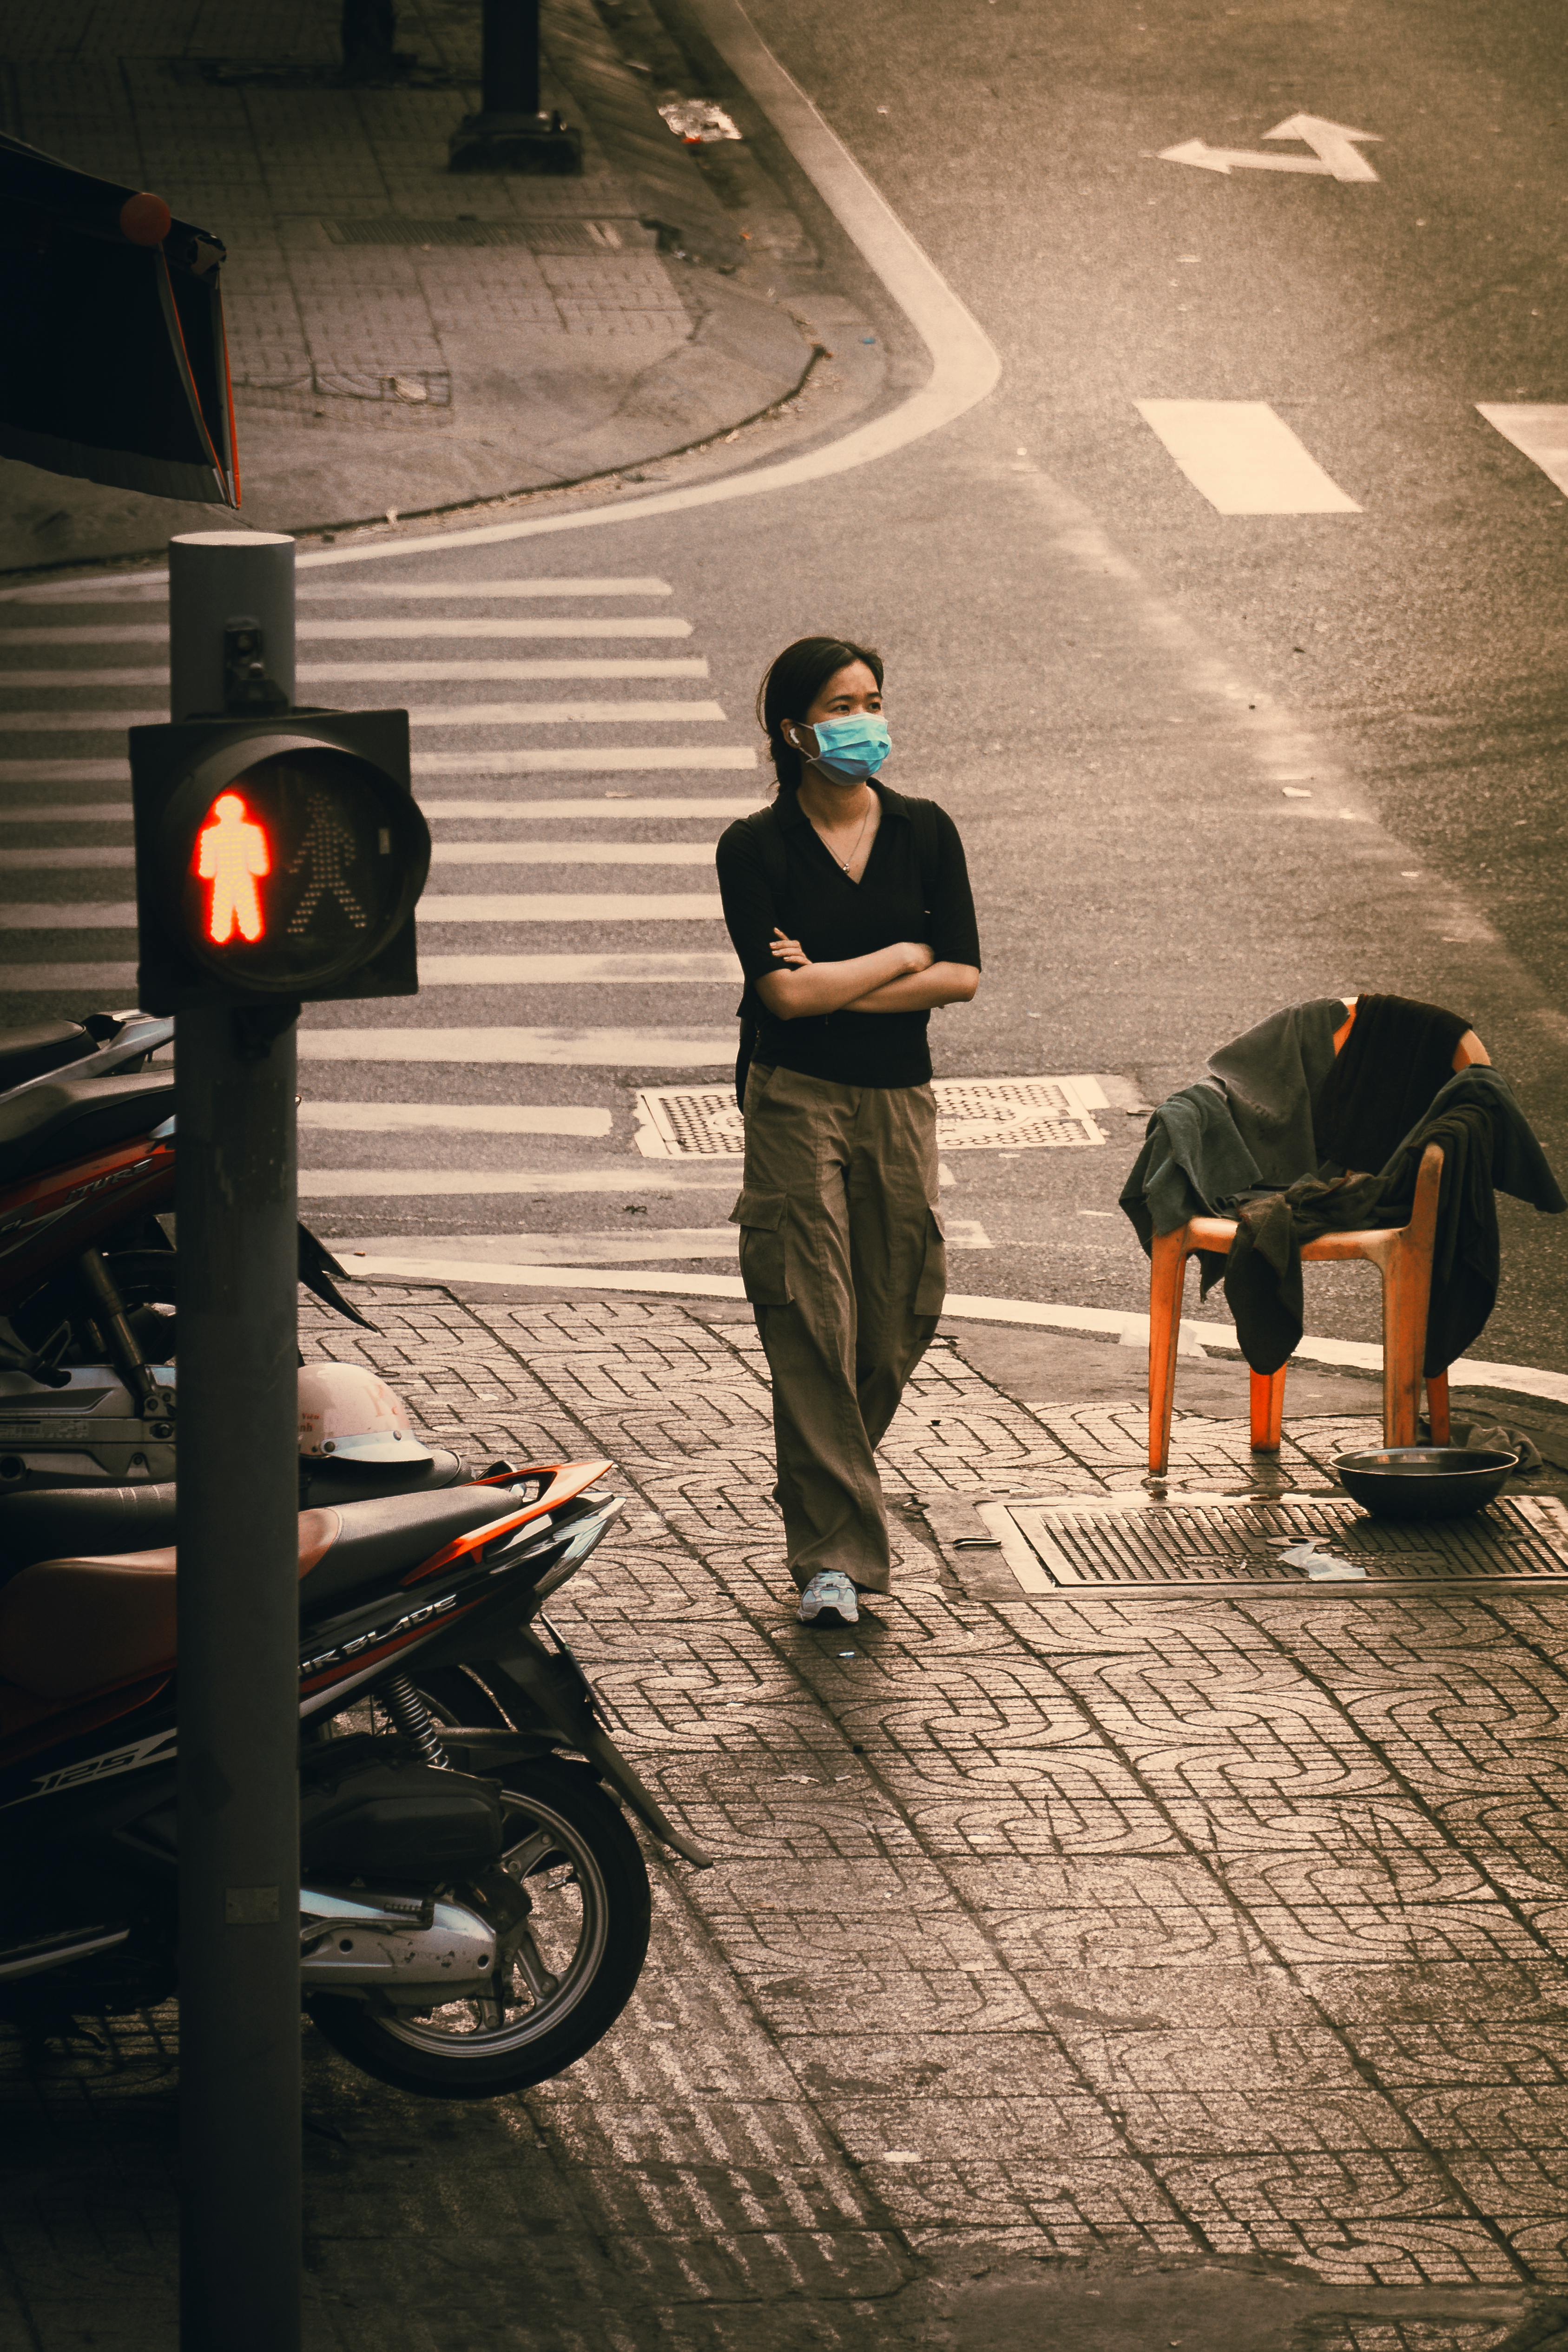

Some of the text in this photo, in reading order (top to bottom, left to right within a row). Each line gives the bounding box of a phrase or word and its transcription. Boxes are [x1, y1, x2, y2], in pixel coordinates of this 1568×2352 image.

[297, 1594, 457, 1676] IR BLADE
[44, 1748, 140, 1791] 125
